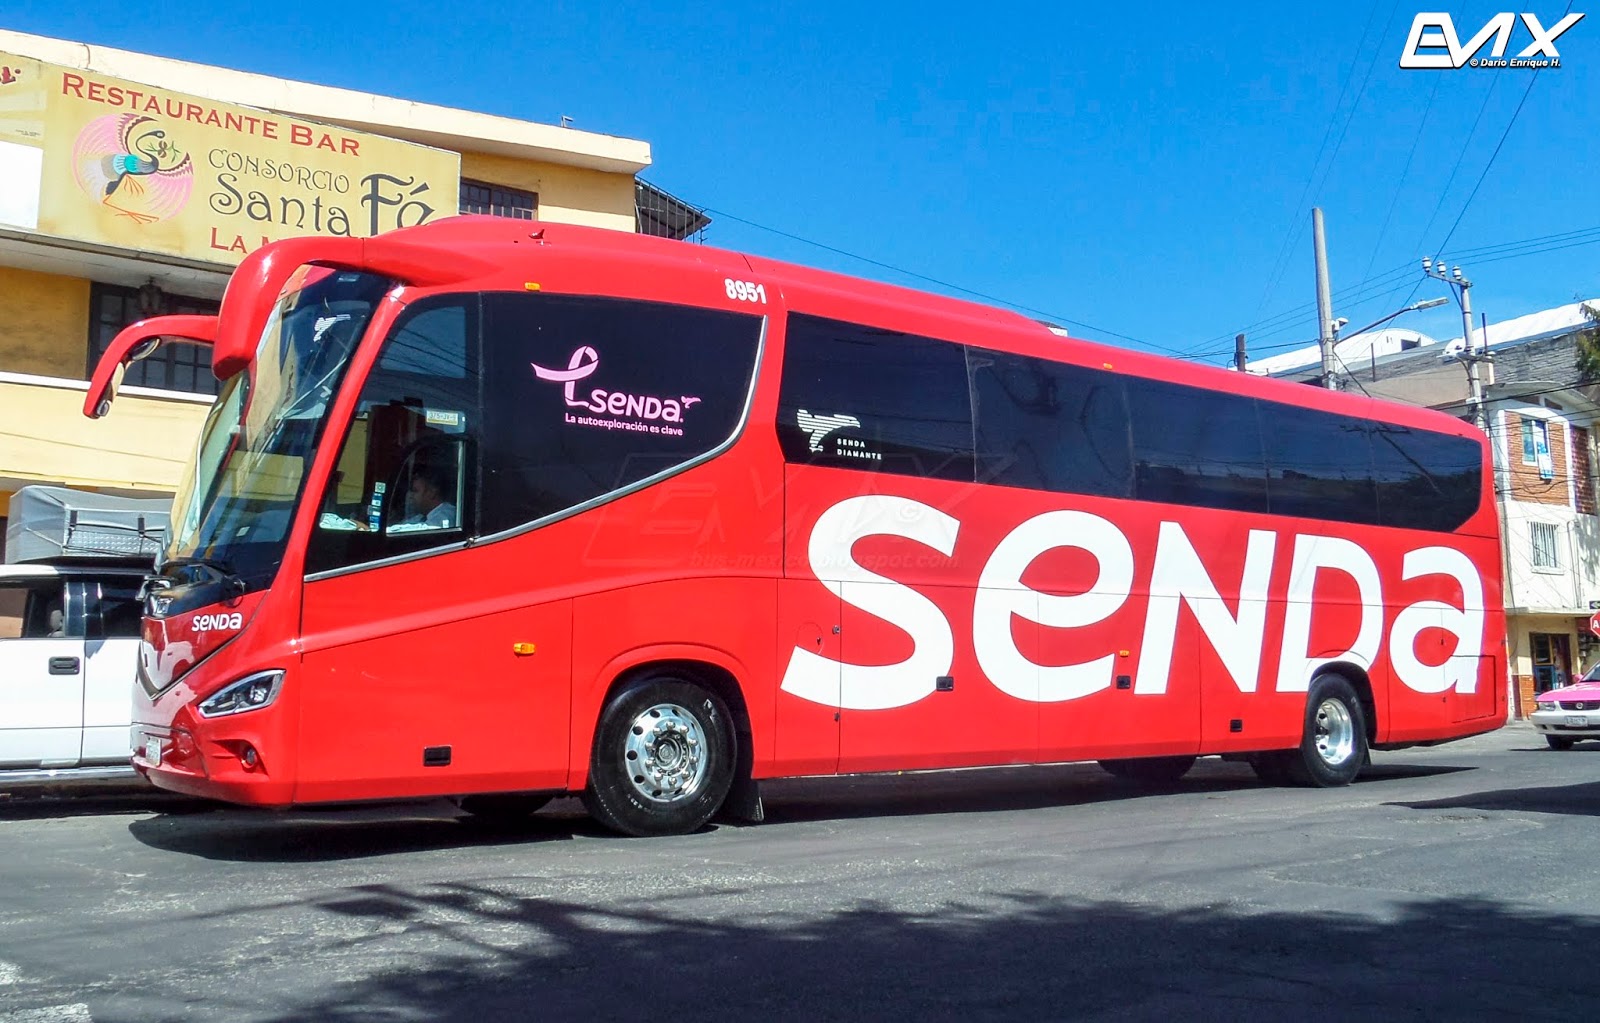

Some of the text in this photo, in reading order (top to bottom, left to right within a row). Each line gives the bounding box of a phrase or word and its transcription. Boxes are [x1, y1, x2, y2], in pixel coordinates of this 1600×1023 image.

[62, 72, 360, 157] RESTAURANTE BAR
[208, 148, 350, 194] CONSORCIO
[209, 173, 358, 239] Santa
[210, 226, 248, 254] LA
[724, 278, 767, 304] 8951
[565, 412, 684, 436] La autoexploración es clave
[837, 438, 866, 448] SENDA
[837, 448, 882, 460] DIAMANTE
